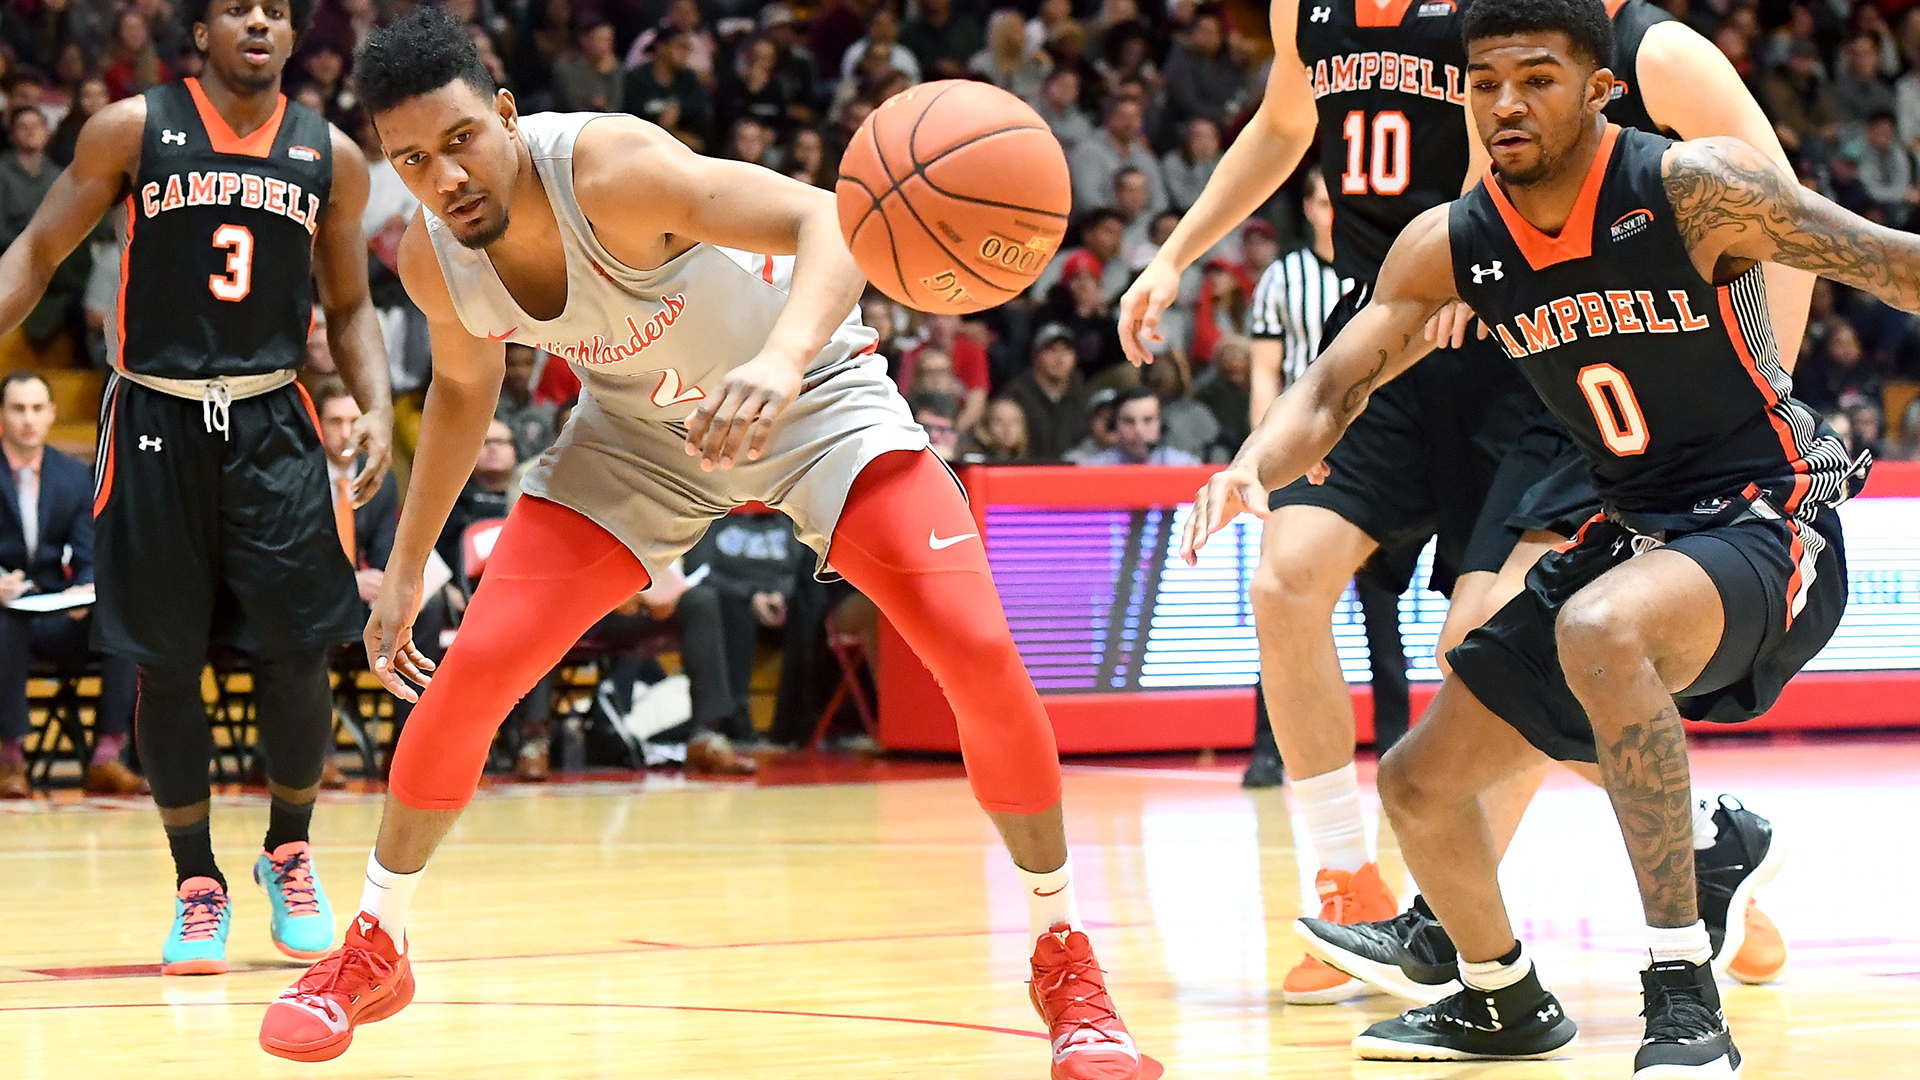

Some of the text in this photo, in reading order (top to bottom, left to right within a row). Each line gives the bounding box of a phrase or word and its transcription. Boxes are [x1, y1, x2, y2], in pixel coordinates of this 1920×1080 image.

[1307, 51, 1465, 106] AMPBELL
[1342, 110, 1411, 195] 10
[142, 172, 319, 235] CAMPBELL
[209, 223, 254, 302] 3
[1490, 290, 1710, 358] AMPBELL
[1576, 362, 1651, 458] 0
